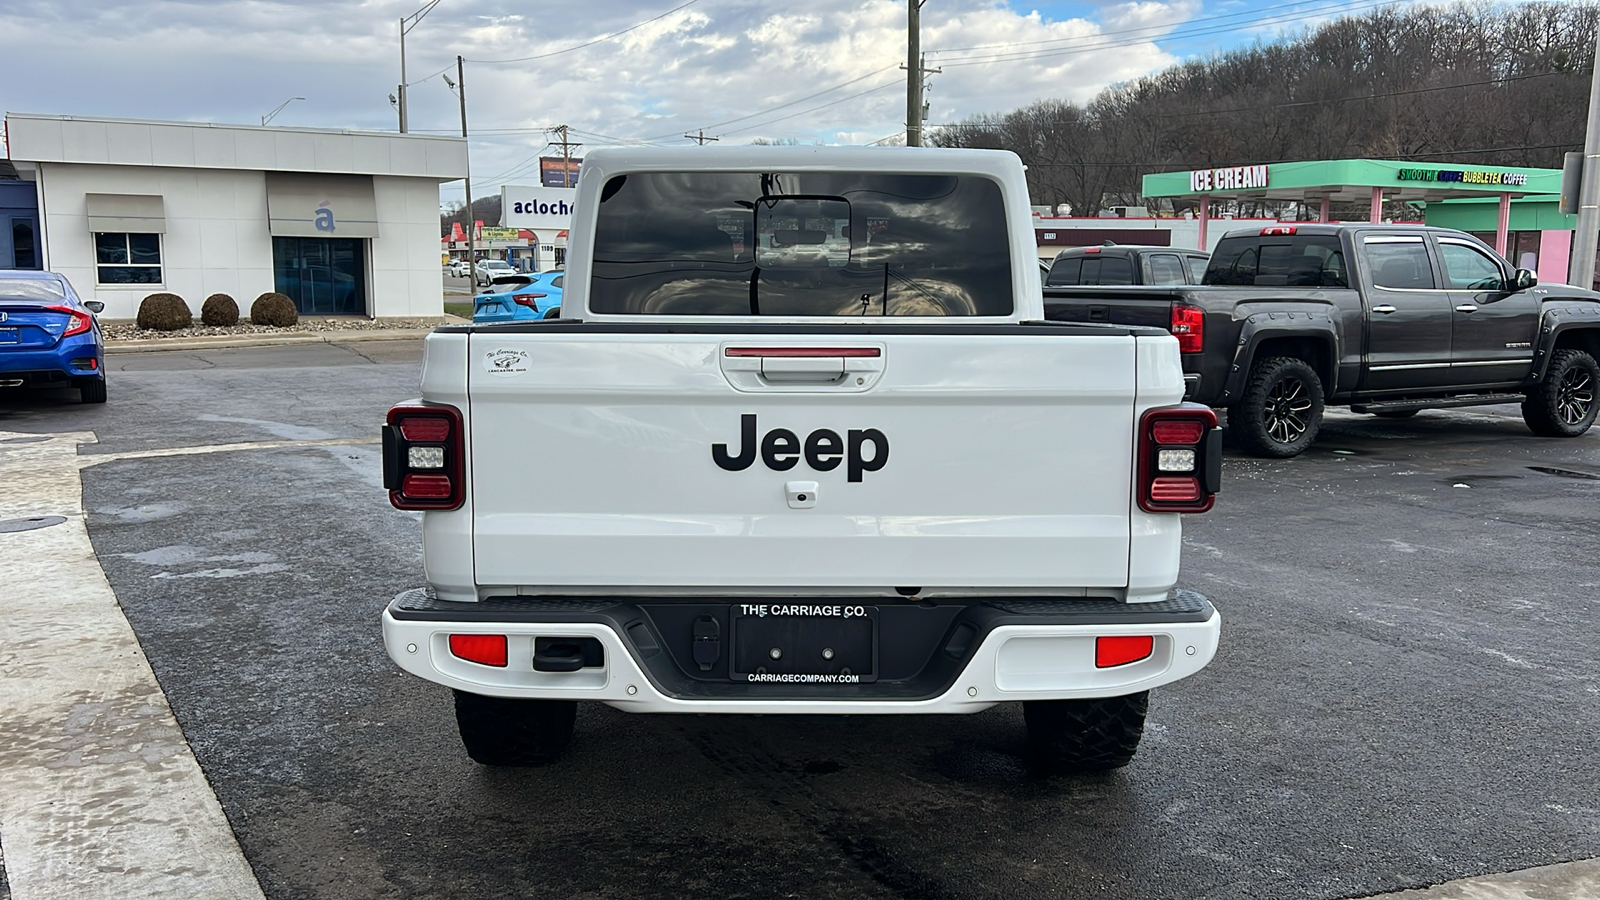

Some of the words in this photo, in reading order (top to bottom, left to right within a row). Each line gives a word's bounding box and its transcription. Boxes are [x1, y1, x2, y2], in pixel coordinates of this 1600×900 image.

[1190, 170, 1213, 191] ICE
[1214, 165, 1268, 190] CREAM
[1463, 171, 1501, 184] BUBBLETEA
[1503, 173, 1527, 185] COFFEE
[712, 414, 889, 482] Jeep
[741, 605, 767, 616] THE
[771, 605, 841, 616] CARRIAGE
[844, 605, 867, 617] CO.
[748, 674, 859, 683] CARRIAGECOMPANY.COM
